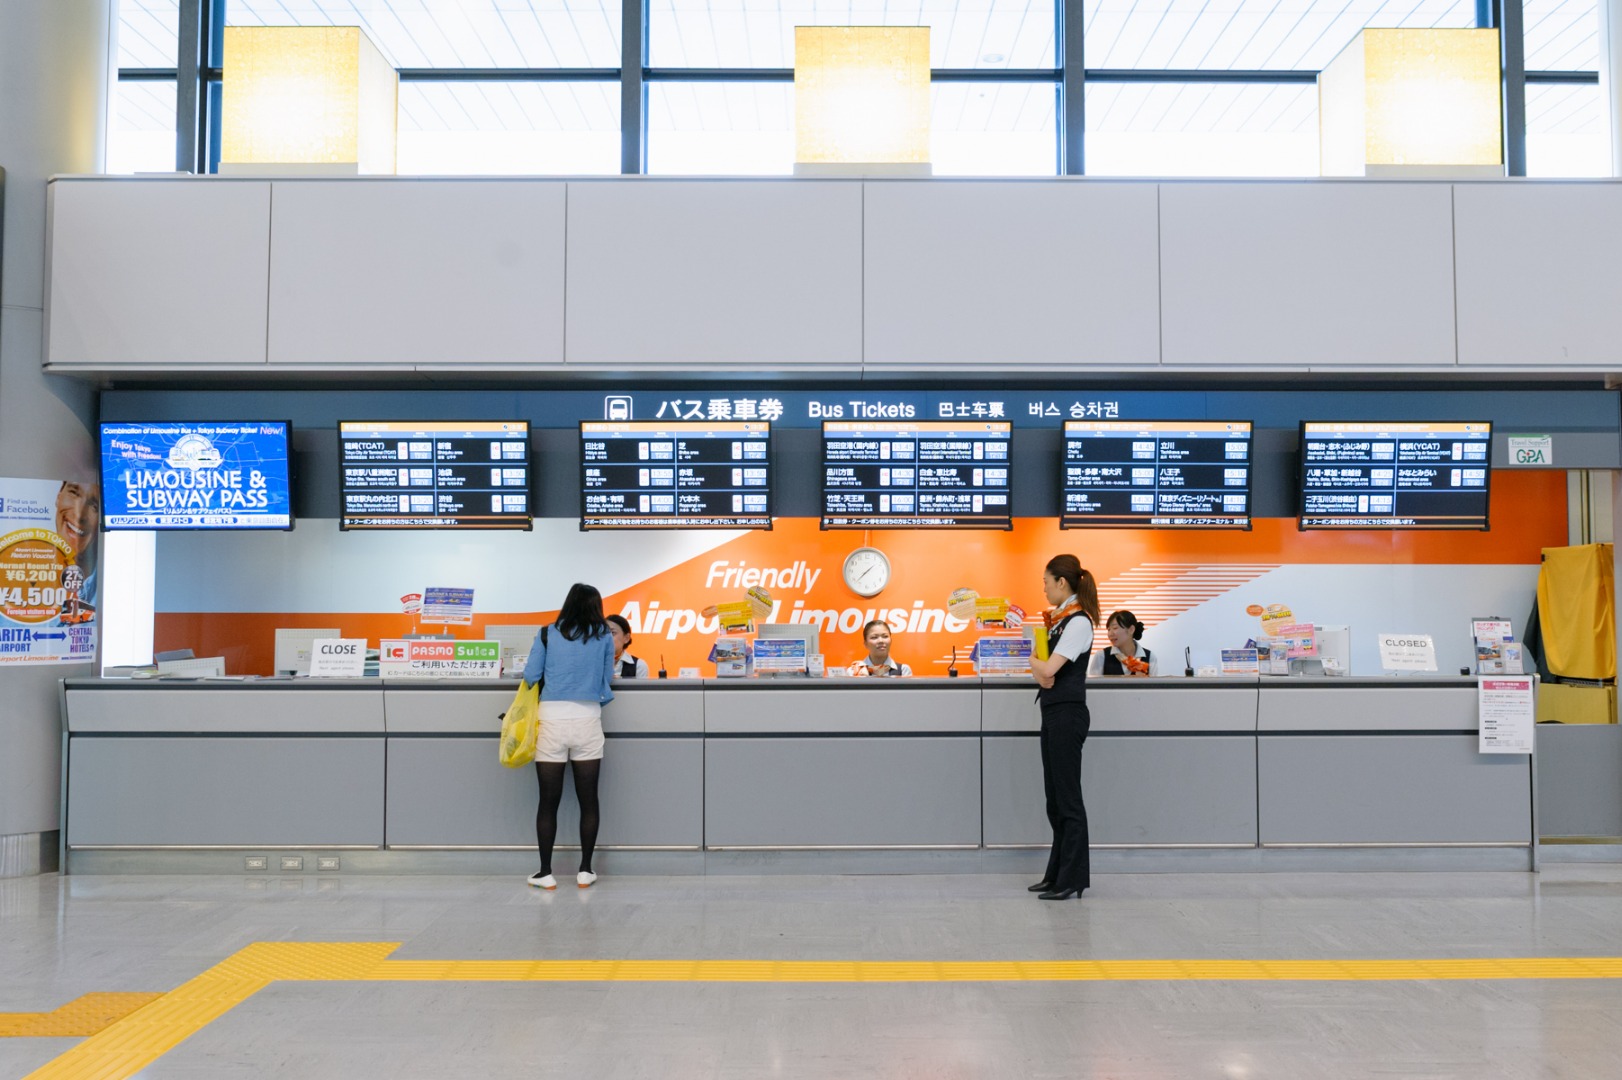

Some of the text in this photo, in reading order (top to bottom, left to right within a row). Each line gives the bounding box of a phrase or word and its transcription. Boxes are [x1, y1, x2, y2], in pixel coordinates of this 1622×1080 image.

[656, 399, 784, 421] バス乗車券
[809, 401, 915, 417] Bus Tickets
[939, 402, 1004, 417] 巴士车票
[1029, 402, 1119, 418] 버스 승차권
[112, 440, 132, 450] Enjoy
[1516, 449, 1545, 463] GPA
[125, 471, 266, 489] LIMOUSINE &
[127, 490, 268, 508] SUBWAY PASS
[7, 506, 49, 514] Facebook
[0, 531, 34, 548] elcome
[47, 532, 72, 554] TOKYO
[6, 570, 56, 582] ¥6,200
[706, 560, 821, 594] Friendly
[64, 581, 81, 589] OFF
[618, 601, 720, 640] Airpo
[0, 629, 31, 641] RITA
[70, 644, 89, 653] HOTELS
[321, 644, 356, 654] CLOSE
[1386, 639, 1427, 647] CLOSED
[412, 646, 453, 656] PASMO
[458, 646, 496, 656] Suica
